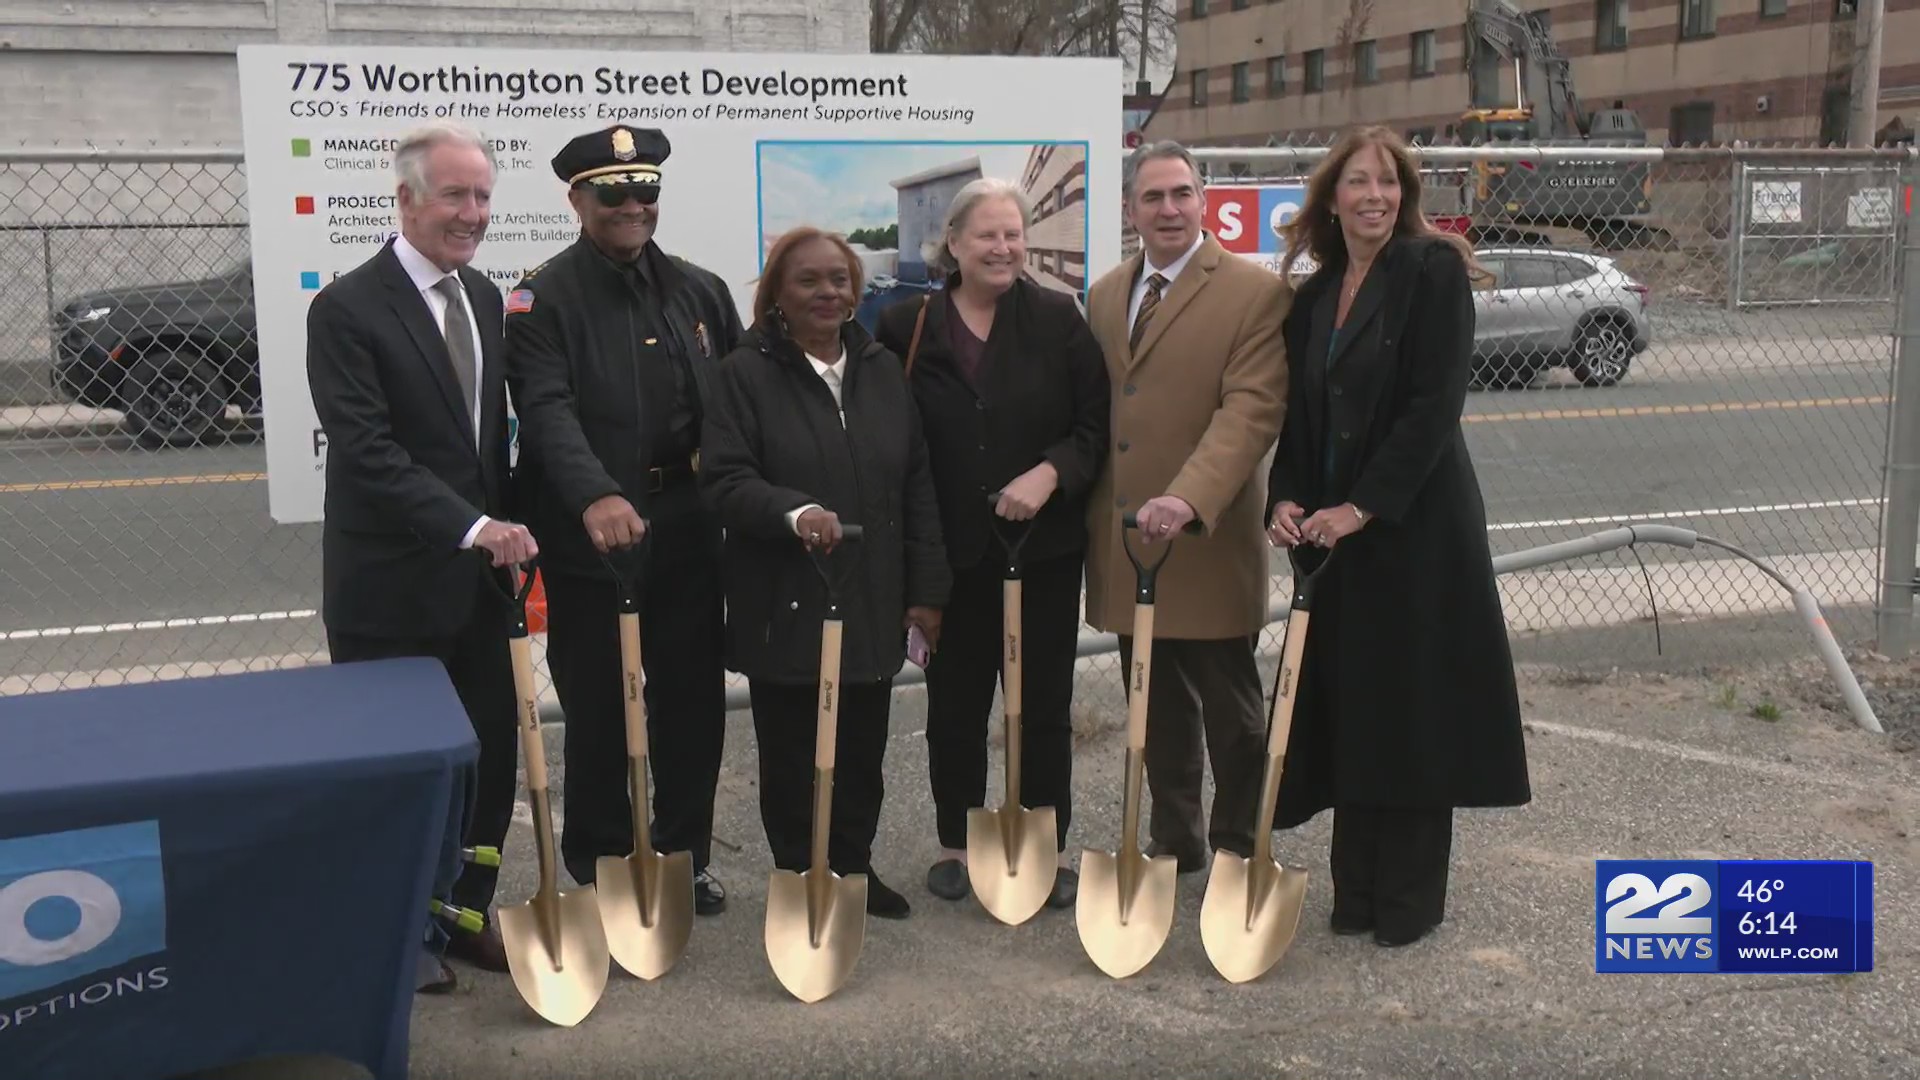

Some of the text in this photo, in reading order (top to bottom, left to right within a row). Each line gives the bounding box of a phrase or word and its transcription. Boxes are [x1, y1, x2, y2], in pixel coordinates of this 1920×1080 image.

[287, 62, 908, 102] 775 Worthington Street Development
[435, 102, 457, 118] of
[460, 102, 490, 118] the
[596, 104, 685, 120] Expansion
[692, 105, 711, 121] of
[715, 105, 808, 121] Permanent
[814, 106, 902, 123] Supportive
[908, 107, 974, 125] Housing
[324, 157, 376, 169] Clinical
[327, 196, 397, 208] PROJECT
[504, 213, 572, 225] Architects,
[329, 231, 385, 244] General
[481, 231, 527, 242] estern
[487, 267, 520, 280] have
